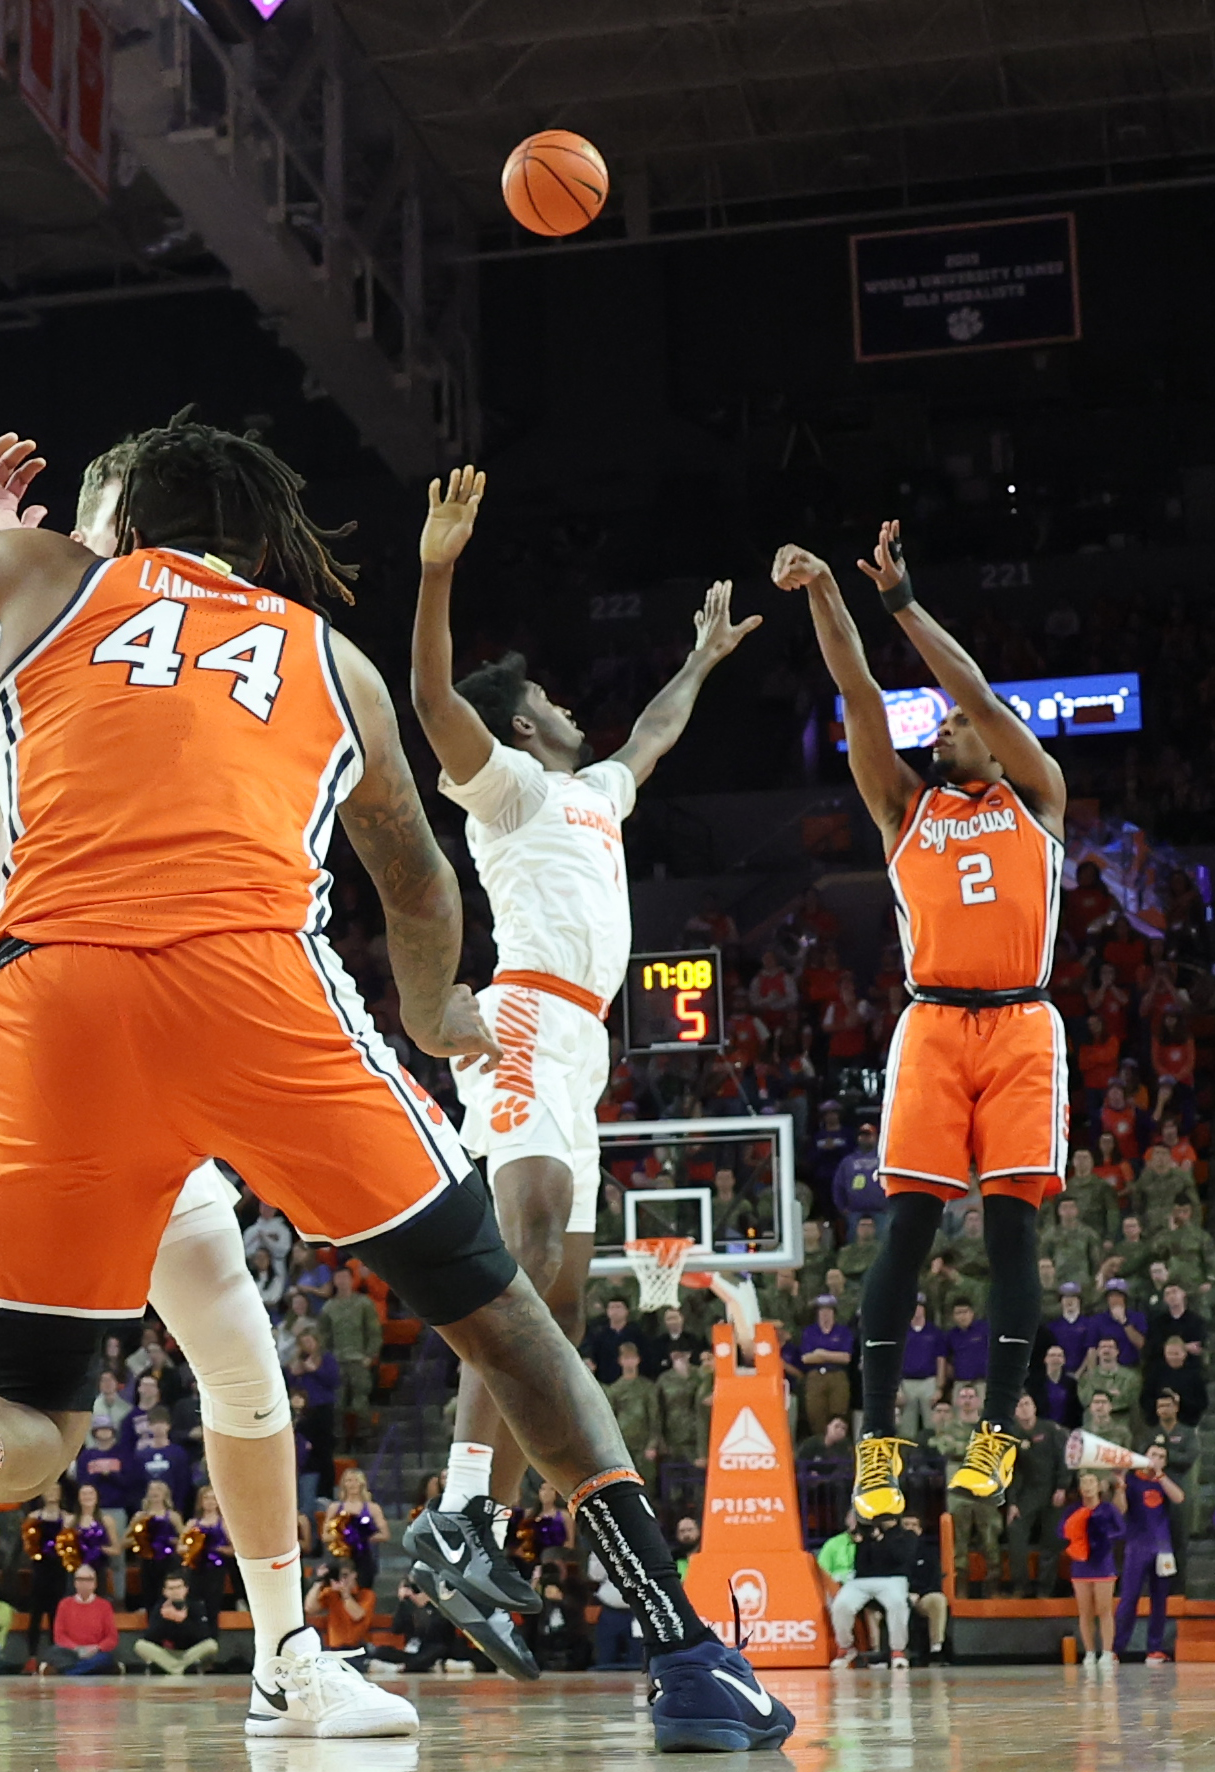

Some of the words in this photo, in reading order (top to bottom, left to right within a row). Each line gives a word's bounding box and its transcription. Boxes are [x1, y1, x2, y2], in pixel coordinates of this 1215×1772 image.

[981, 561, 1029, 589] 221
[589, 592, 642, 620] 222
[90, 597, 288, 725] 44
[919, 807, 1018, 855] Syracuse
[957, 852, 998, 906] 2
[643, 960, 712, 990] 17:08
[675, 990, 707, 1041] 5
[718, 1455, 777, 1471] CITGO
[710, 1496, 786, 1514] PRISMA
